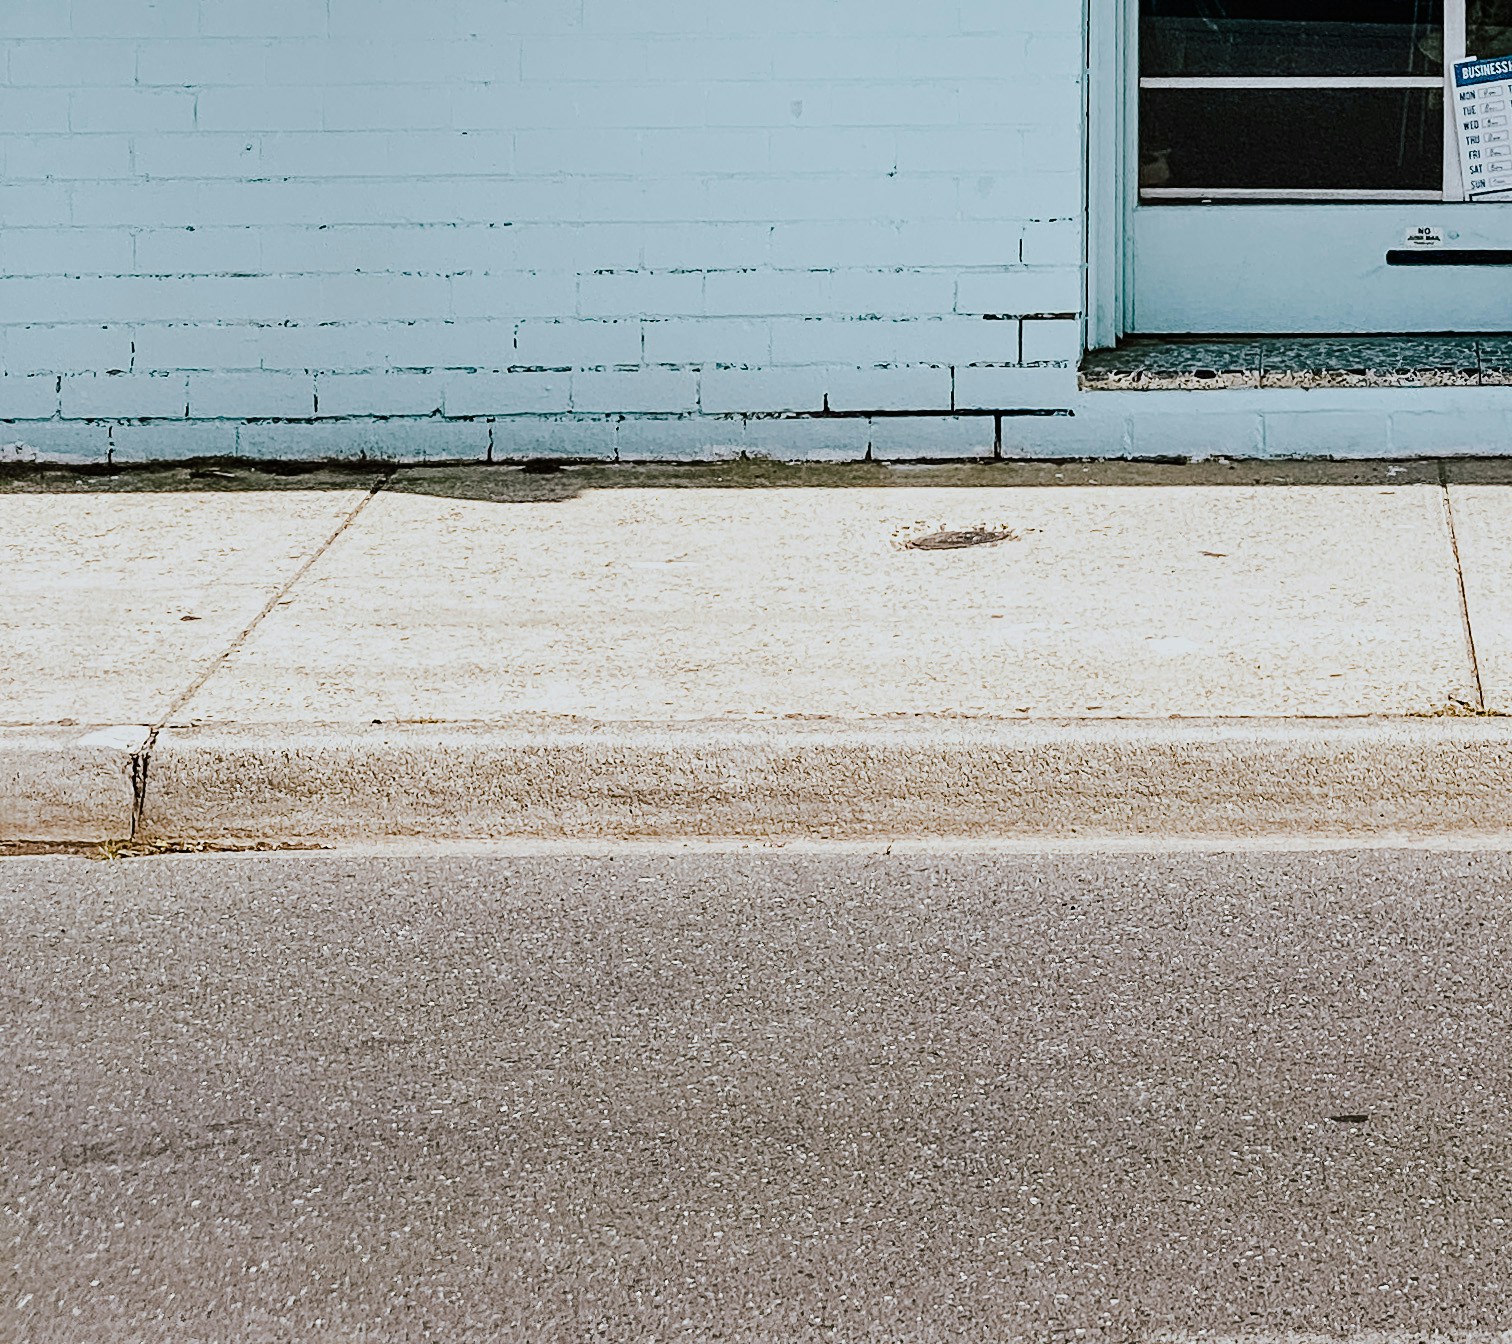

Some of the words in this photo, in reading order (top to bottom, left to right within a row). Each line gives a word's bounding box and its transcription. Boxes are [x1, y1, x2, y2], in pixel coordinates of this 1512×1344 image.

[1462, 60, 1509, 79] BUSINESS
[1459, 90, 1476, 101] MON
[1463, 105, 1476, 116] TUE
[1463, 120, 1479, 130] WED
[1466, 135, 1480, 145] THU
[1468, 150, 1480, 159] FRI
[1469, 164, 1482, 174] SAT
[1471, 179, 1486, 190] SUN
